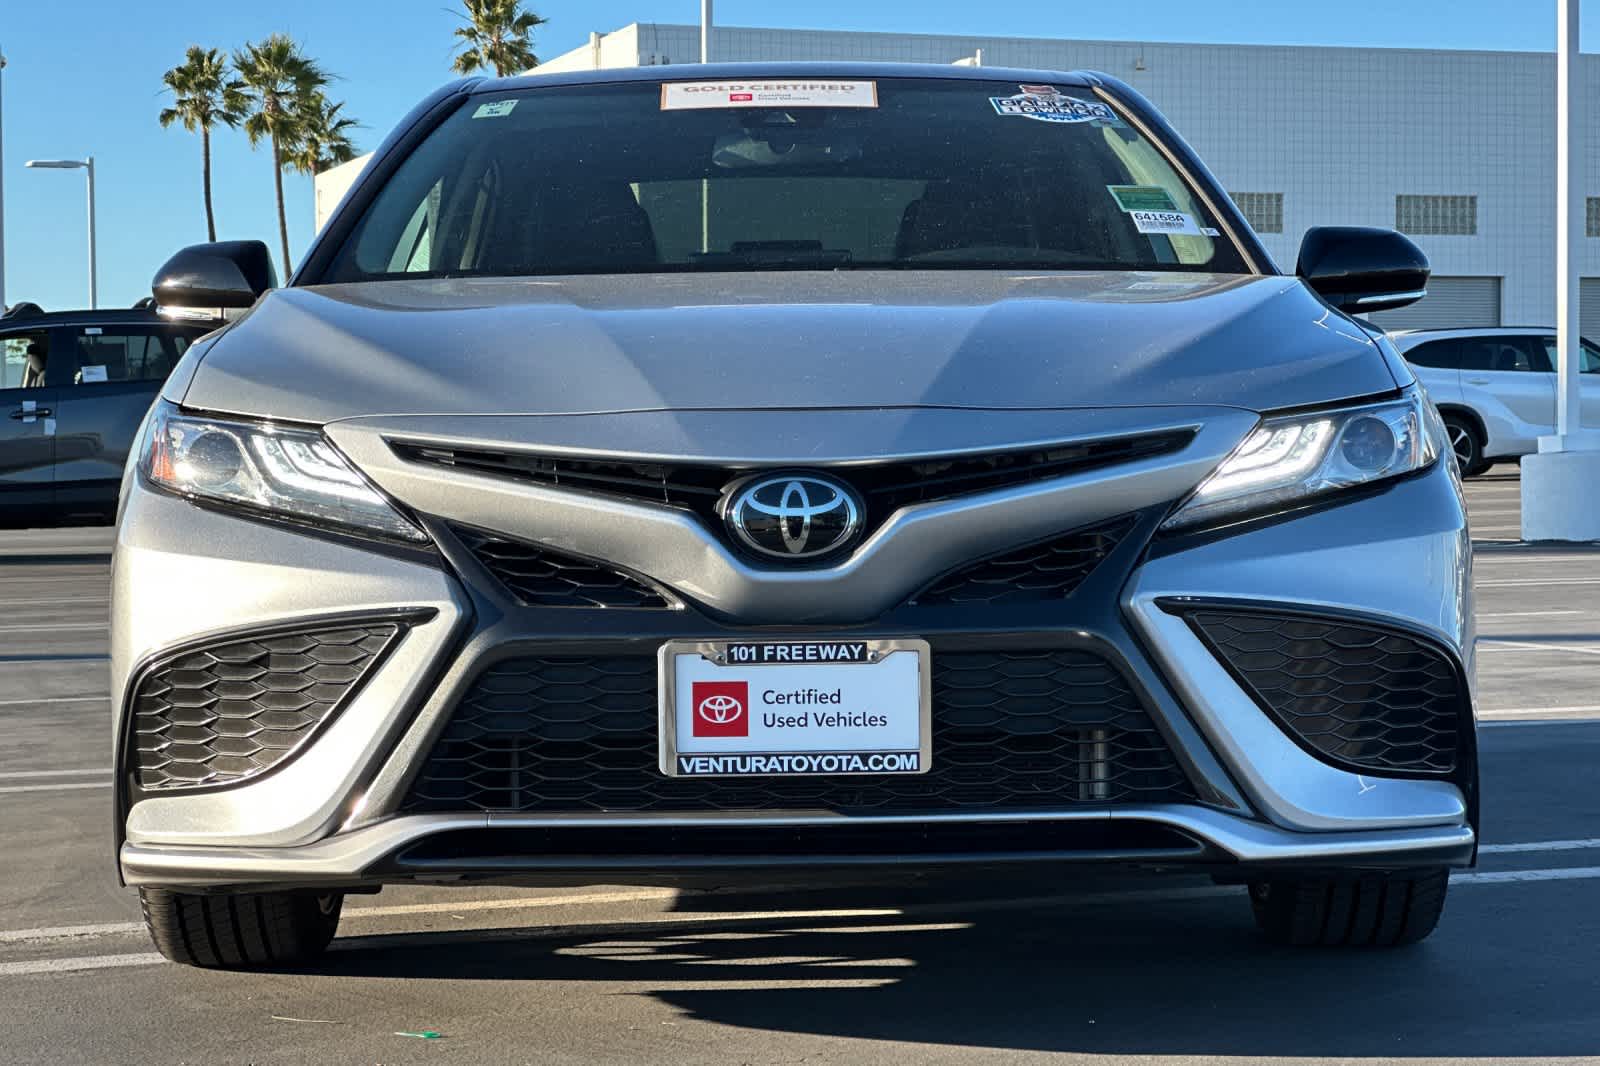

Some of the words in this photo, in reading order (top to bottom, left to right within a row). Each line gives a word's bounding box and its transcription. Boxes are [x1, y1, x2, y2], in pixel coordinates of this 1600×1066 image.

[684, 84, 744, 93] GOLD
[1000, 99, 1104, 110] CARFAX
[1022, 106, 1107, 116] OWNER
[1134, 212, 1185, 222] 64158A
[730, 646, 757, 661] 101
[763, 645, 863, 661] FREEWAY
[762, 689, 841, 705] Certified
[763, 712, 808, 728] Used
[813, 711, 888, 728] Vehicles
[680, 754, 918, 774] VENTURATOYOTA.COM
